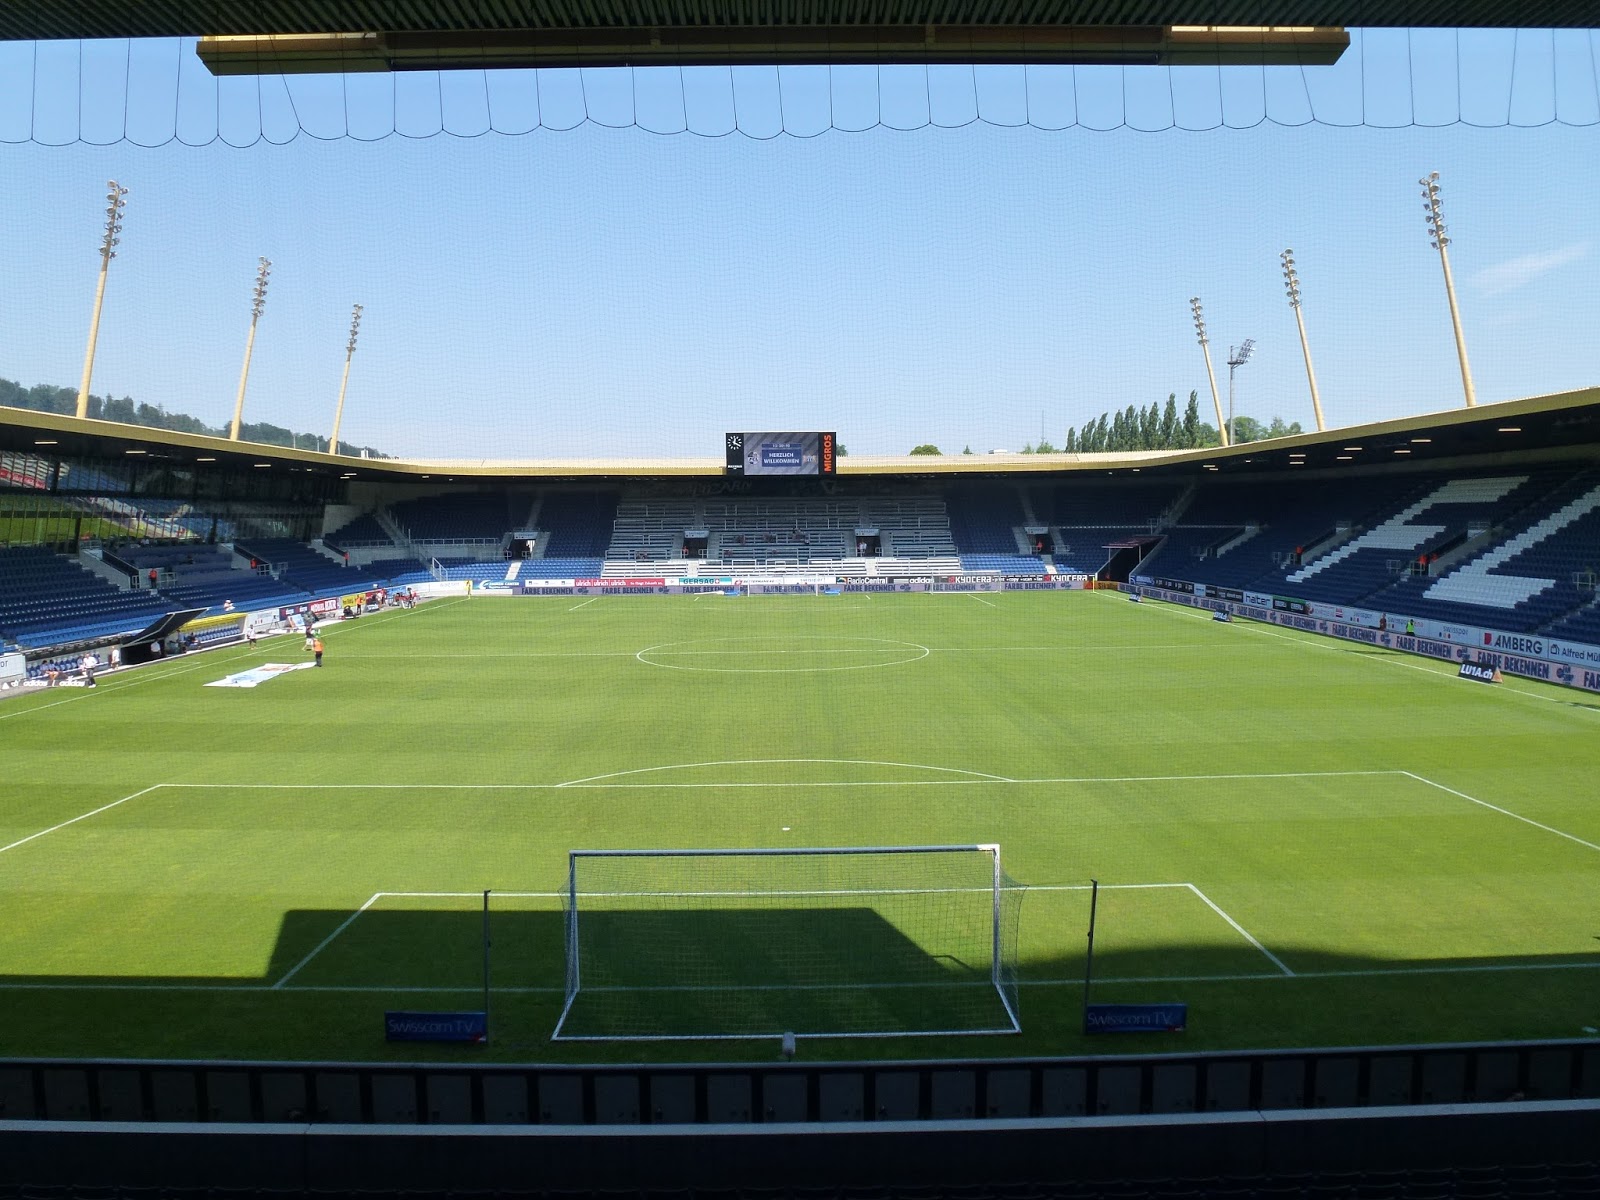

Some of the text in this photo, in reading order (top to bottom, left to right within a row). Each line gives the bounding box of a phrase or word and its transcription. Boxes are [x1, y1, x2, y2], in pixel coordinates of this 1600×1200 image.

[824, 434, 832, 472] MIGROS
[955, 575, 992, 583] KYOCERA
[1051, 574, 1088, 582] KYOCERA
[522, 587, 574, 595] FARBE BEKENNEN
[945, 583, 976, 591] BEKENNEN
[1004, 582, 1023, 590] FARBE
[1246, 594, 1270, 605] halter
[1332, 623, 1377, 643] FARBE BEKENNEN
[1396, 636, 1452, 658] FARBE BEKENNEN
[1494, 634, 1543, 654] AMBERG
[1562, 647, 1585, 660] Alfred
[1477, 650, 1549, 679] FARBE BEKENNEN
[1461, 664, 1494, 680] LU1A.ch
[1087, 1011, 1172, 1026] Swisscom TV
[387, 1019, 474, 1033] Swisscom TV
